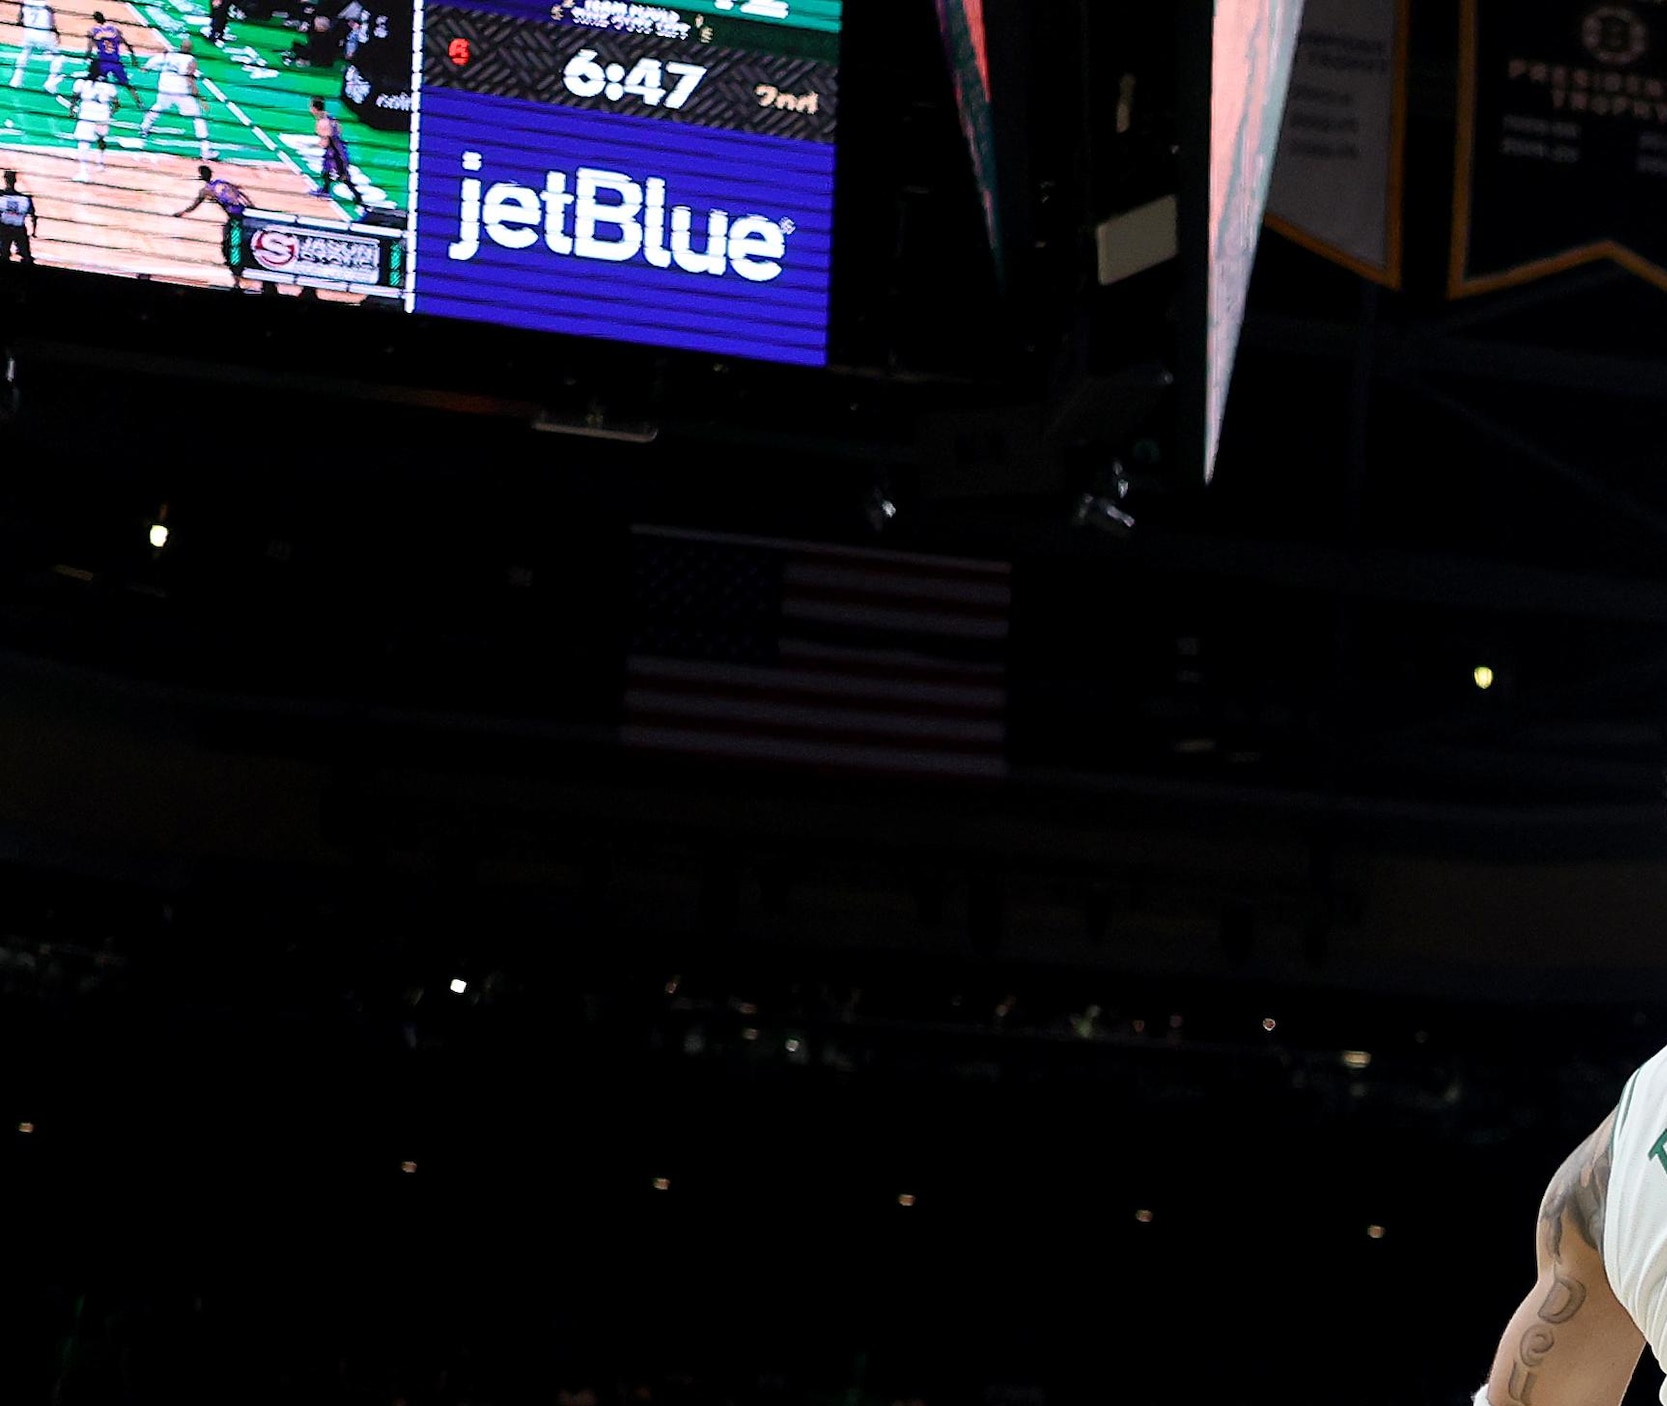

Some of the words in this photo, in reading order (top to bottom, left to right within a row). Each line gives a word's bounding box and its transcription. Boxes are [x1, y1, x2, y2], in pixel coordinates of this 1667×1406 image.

[562, 48, 708, 110] 6:47
[753, 83, 820, 116] 2nd
[448, 151, 787, 283] jetBlue
